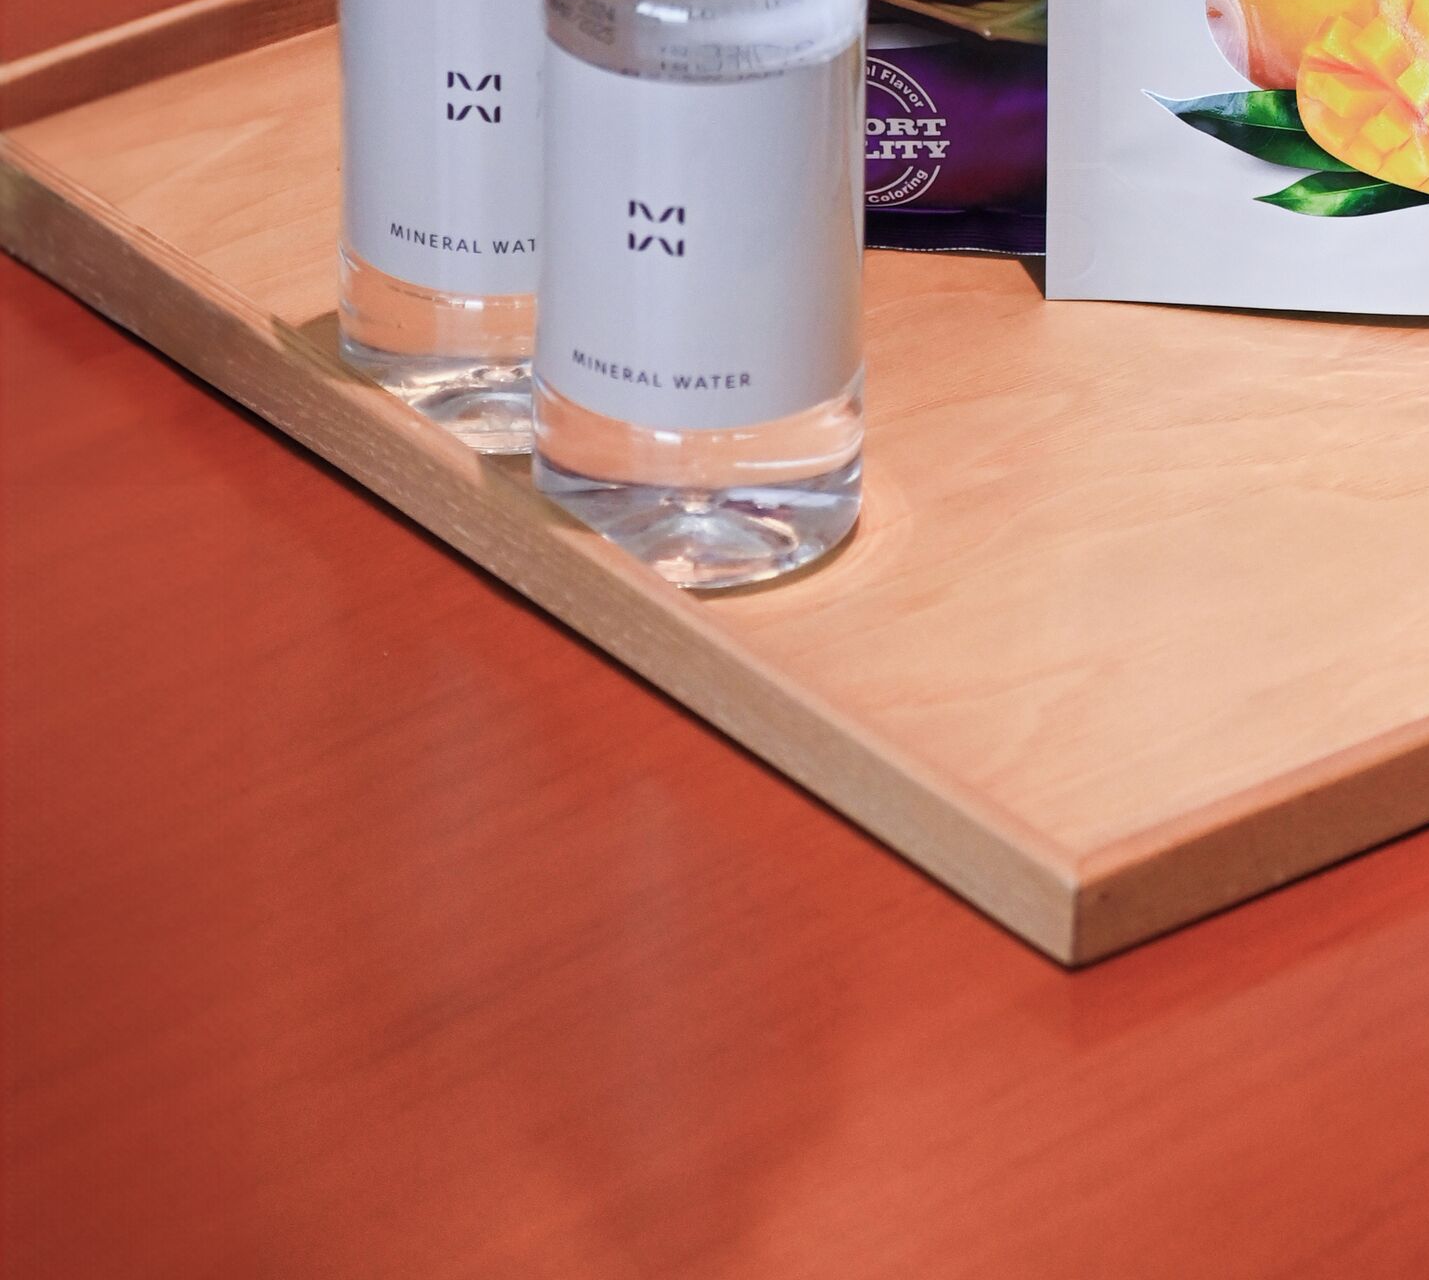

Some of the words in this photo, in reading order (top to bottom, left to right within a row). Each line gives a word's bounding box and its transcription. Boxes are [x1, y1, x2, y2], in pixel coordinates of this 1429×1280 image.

[880, 68, 924, 108] Flavor
[866, 118, 947, 136] ORT
[865, 140, 951, 159] LITY
[868, 169, 929, 203] Coloring
[390, 223, 482, 254] MINERAL
[493, 239, 536, 254] WAT
[572, 349, 663, 388] MINERAL
[673, 363, 751, 390] WATER
